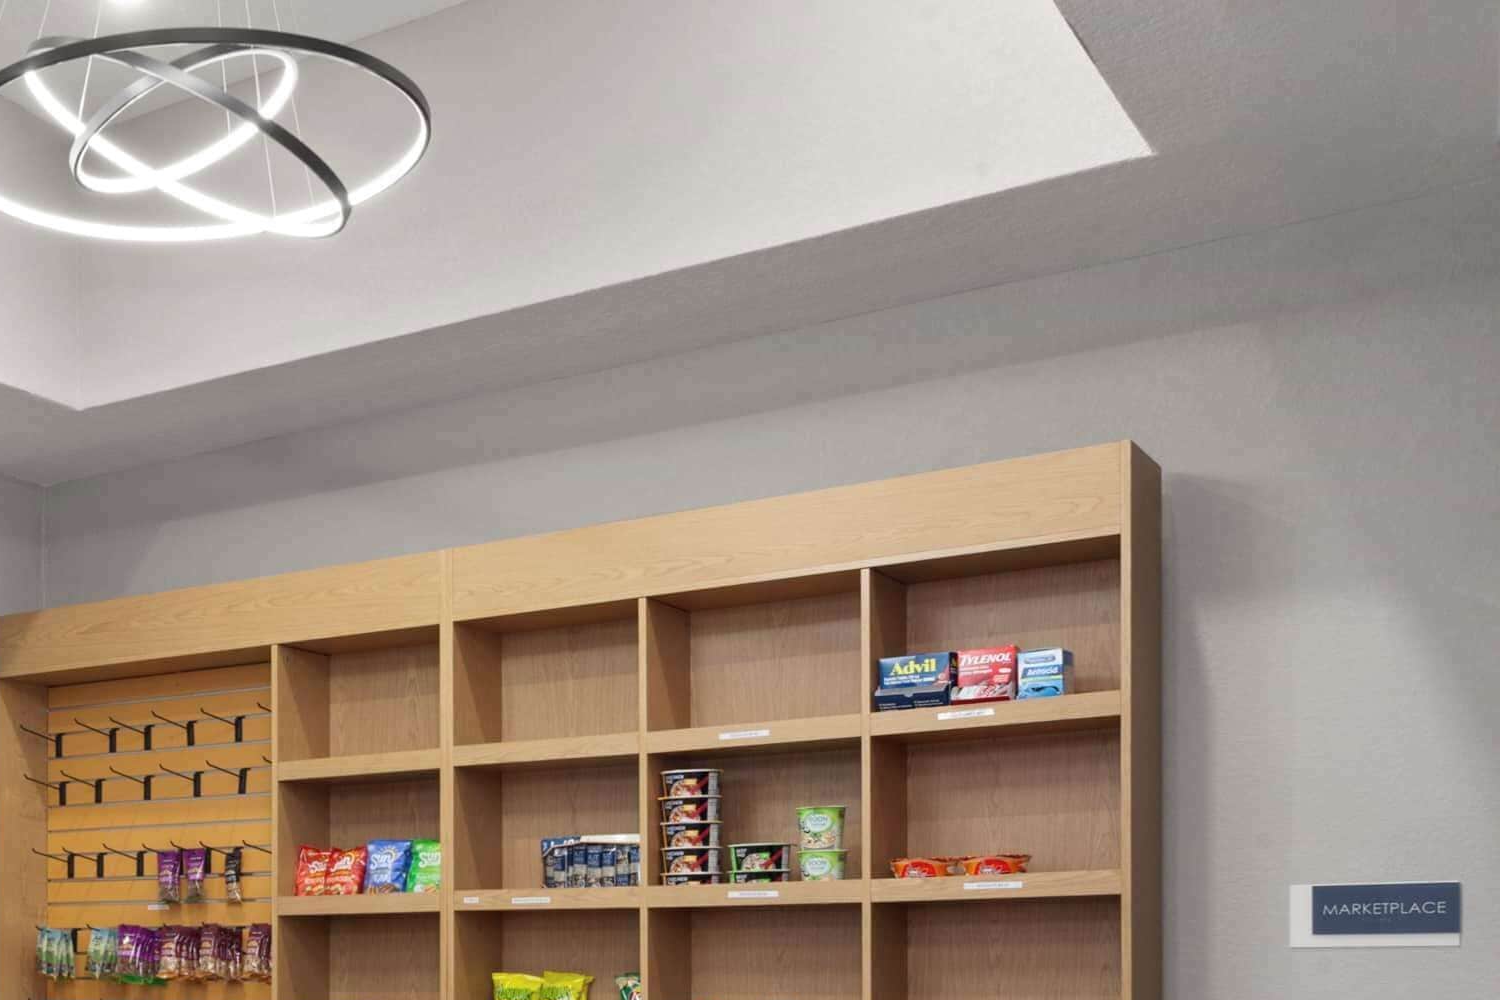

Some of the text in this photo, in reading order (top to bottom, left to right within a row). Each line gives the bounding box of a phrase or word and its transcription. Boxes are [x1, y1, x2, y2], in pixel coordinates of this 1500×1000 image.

[960, 651, 1013, 666] TYLENOL
[890, 658, 937, 676] Advil
[1322, 901, 1447, 916] MARKETPLACE
